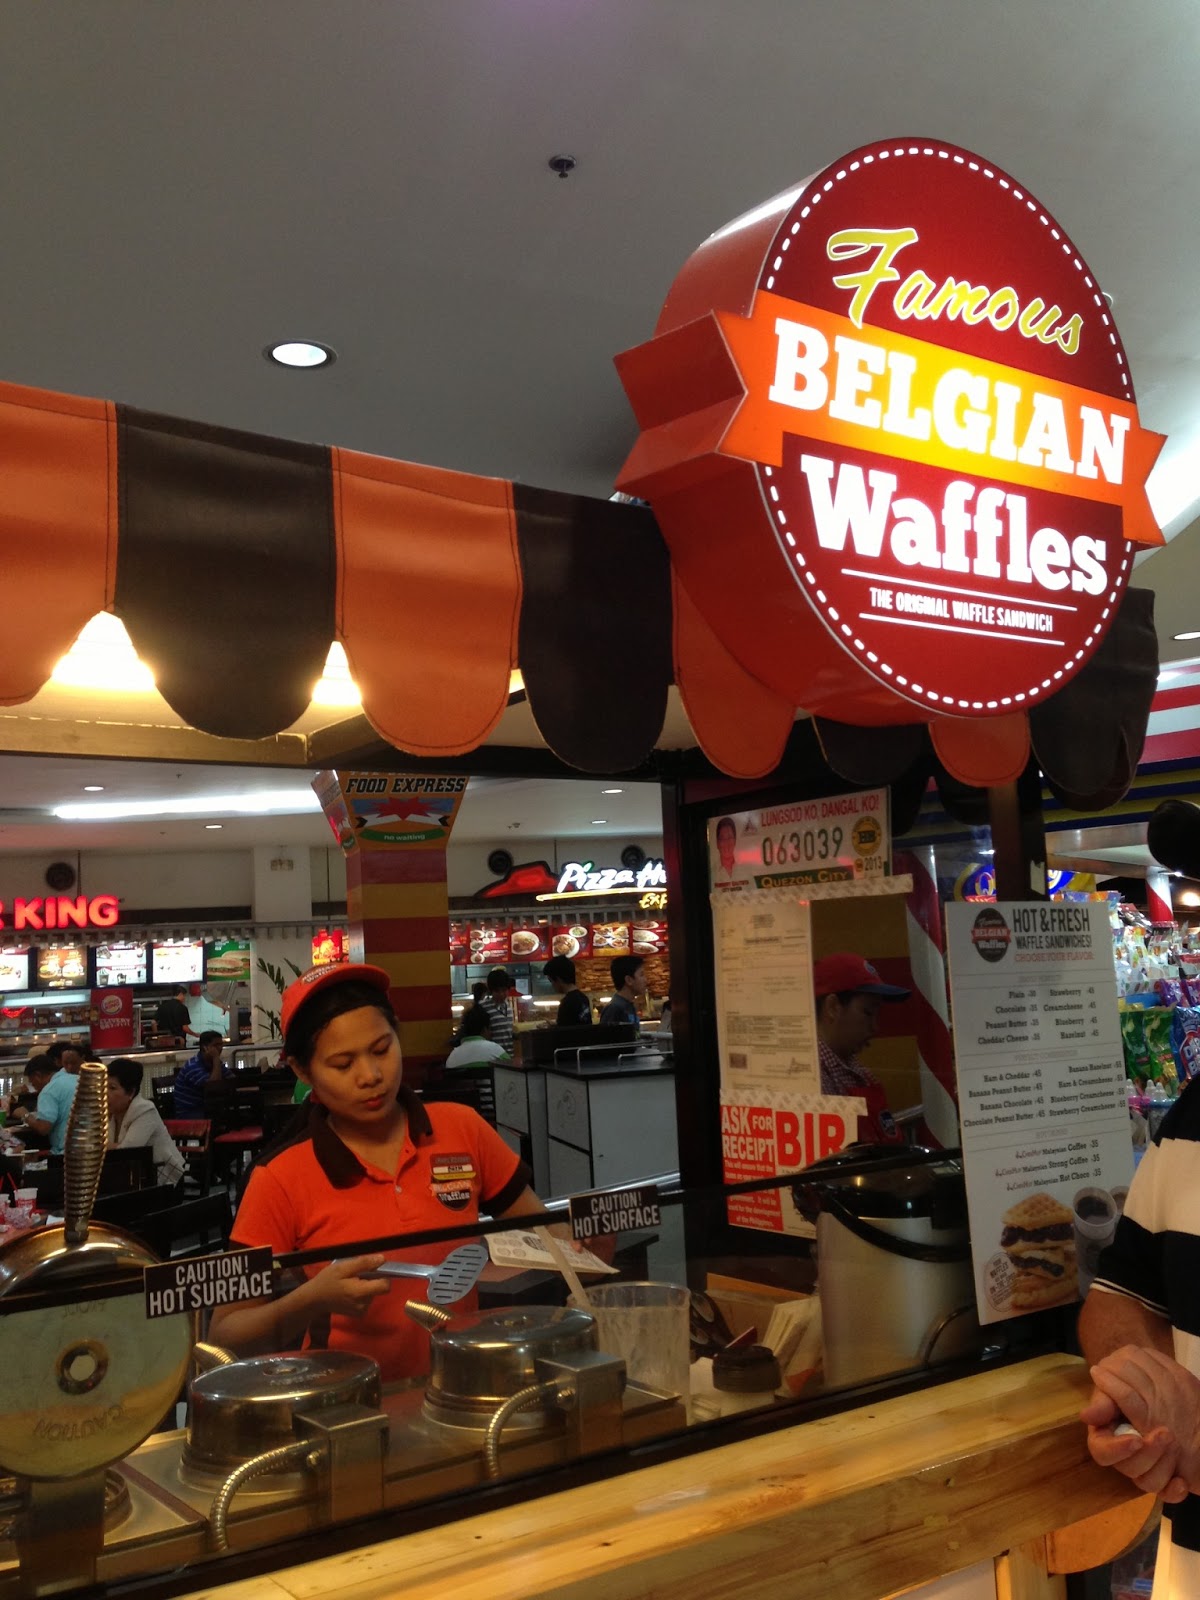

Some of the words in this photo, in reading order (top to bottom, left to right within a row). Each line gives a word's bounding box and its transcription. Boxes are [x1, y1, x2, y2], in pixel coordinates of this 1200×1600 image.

[826, 228, 1084, 355] Famous
[768, 317, 1131, 485] BELGIAN
[801, 453, 1108, 596] Waffles
[869, 587, 893, 610] THE
[895, 591, 950, 618] ORIGINAL
[952, 600, 995, 625] WAFFLE
[996, 606, 1053, 632] SANDWICH
[345, 778, 388, 793] FOOD
[391, 777, 466, 793] EXPRESS
[761, 807, 802, 827] LUNGSOD
[821, 799, 859, 818] DANGAL
[396, 833, 425, 842] waiting
[762, 826, 844, 867] 063039
[864, 857, 882, 871] 2013
[557, 861, 634, 893] Pizza
[14, 894, 119, 931] KING
[1013, 908, 1038, 932] HOT
[1050, 908, 1091, 932] FRESH
[1015, 935, 1044, 950] WAFFLE
[1045, 934, 1092, 949] SANDWICHES!
[1049, 988, 1081, 997] Strawberry
[995, 1006, 1026, 1014] Chocolate
[986, 1021, 1007, 1029] Peanut
[1008, 1020, 1028, 1028] Butter
[1055, 1018, 1084, 1026] Blueberry
[978, 1036, 1005, 1045] Cheddar
[1006, 1035, 1029, 1043] Cheese
[1068, 1065, 1088, 1073] Banana
[984, 1074, 998, 1083] Ham
[1005, 1072, 1030, 1080] Cheddar
[969, 1090, 991, 1098] Banana
[992, 1087, 1012, 1095] Peanut
[1014, 1085, 1031, 1093] Butter
[1050, 1094, 1078, 1103] Blueberry
[980, 1102, 1002, 1111] Banana
[1003, 1099, 1033, 1108] Chocolate
[1049, 1107, 1080, 1117] Strawberry
[722, 1106, 752, 1135] ASK
[752, 1115, 773, 1131] FOR
[963, 1118, 993, 1128] Chocolate
[994, 1115, 1015, 1123] Peanut
[1016, 1113, 1034, 1121] Butter
[775, 1111, 846, 1167] BIR
[722, 1134, 774, 1163] RECEIPT
[1067, 1142, 1087, 1152] Coffee
[1048, 1160, 1068, 1169] Strong
[1069, 1156, 1089, 1166] Coffee
[1059, 1174, 1070, 1183] Hot
[1071, 1171, 1090, 1180] Choco
[439, 1191, 471, 1202] Waffles
[590, 1191, 642, 1214] CAUTION!
[574, 1215, 600, 1239] HOT
[602, 1204, 660, 1233] SURFACE
[175, 1255, 249, 1286] CAUTION!
[149, 1286, 186, 1316] HOT
[190, 1270, 273, 1309] SURFACE
